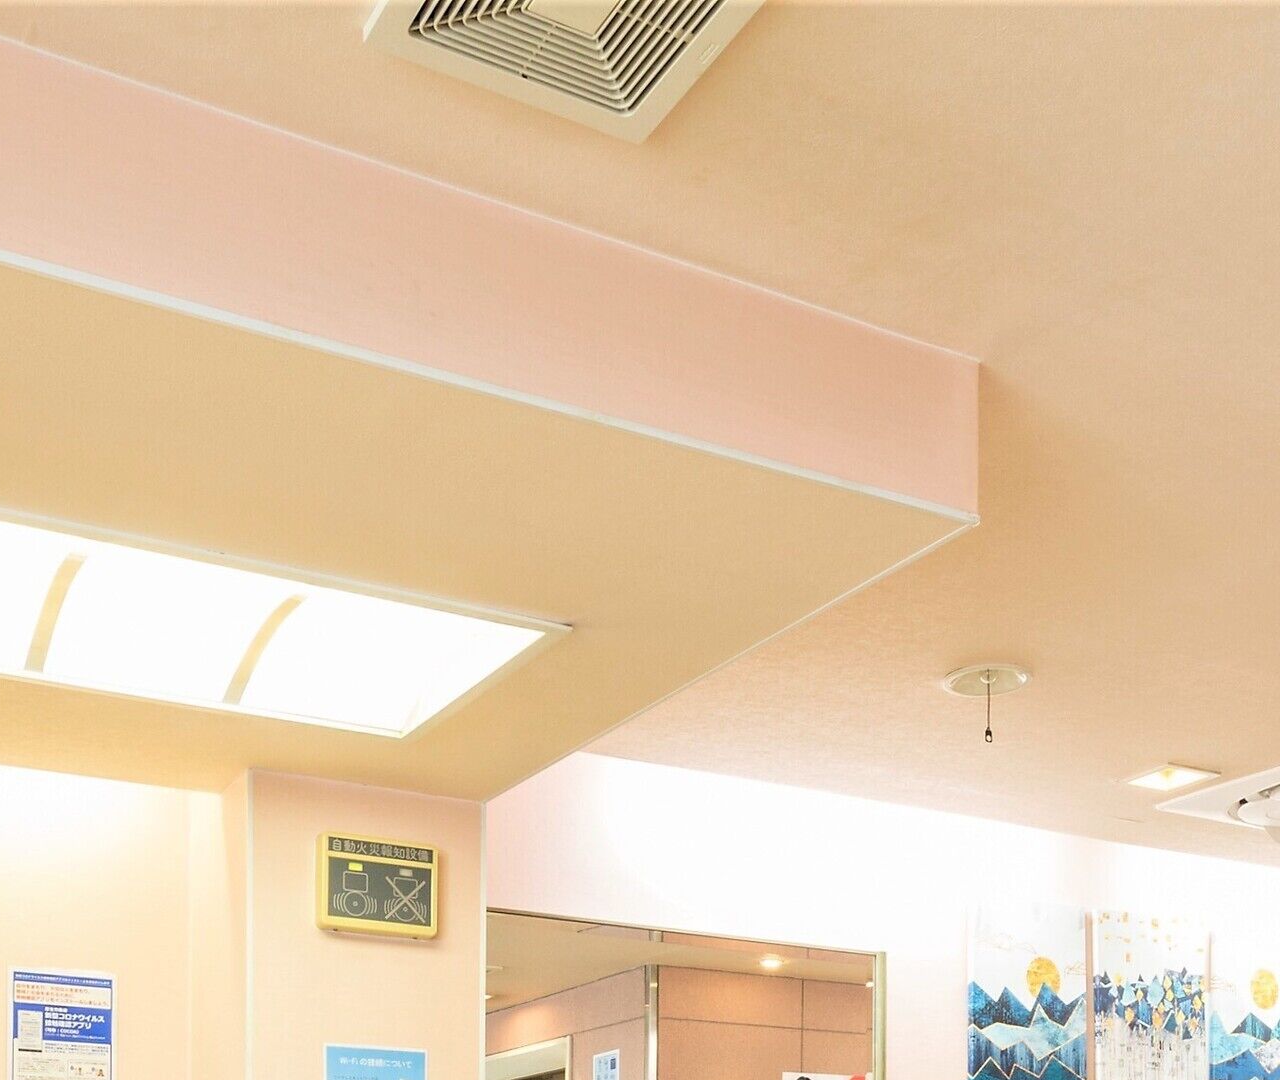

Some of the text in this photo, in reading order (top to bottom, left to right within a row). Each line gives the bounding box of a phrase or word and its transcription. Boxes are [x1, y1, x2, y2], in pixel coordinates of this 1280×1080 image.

[332, 838, 429, 862] 自動火災報知設備
[44, 1012, 105, 1023] 新型コロナウイルス
